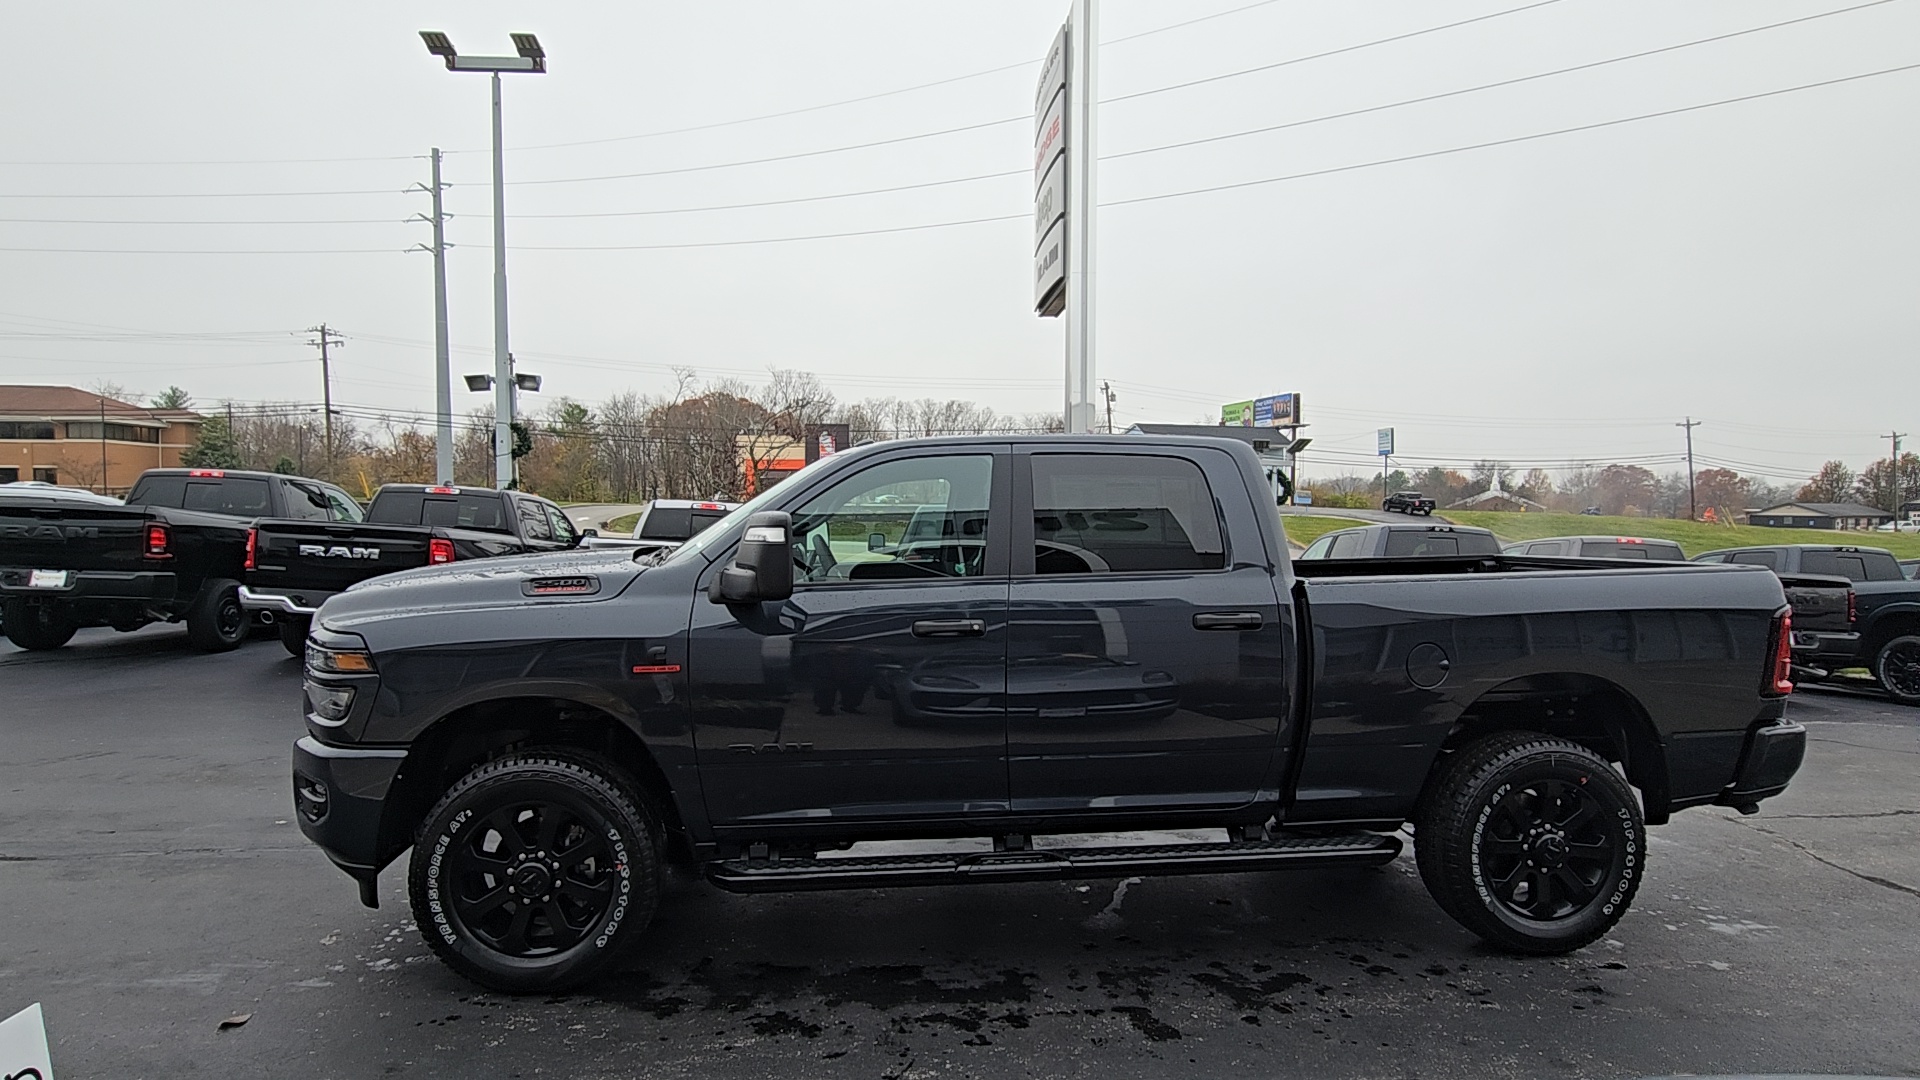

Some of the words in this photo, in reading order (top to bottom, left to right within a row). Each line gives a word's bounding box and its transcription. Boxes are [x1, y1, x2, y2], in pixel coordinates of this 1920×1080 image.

[0, 524, 99, 539] RAM
[299, 544, 380, 559] RAM
[427, 834, 457, 945] TRANSFORCE
